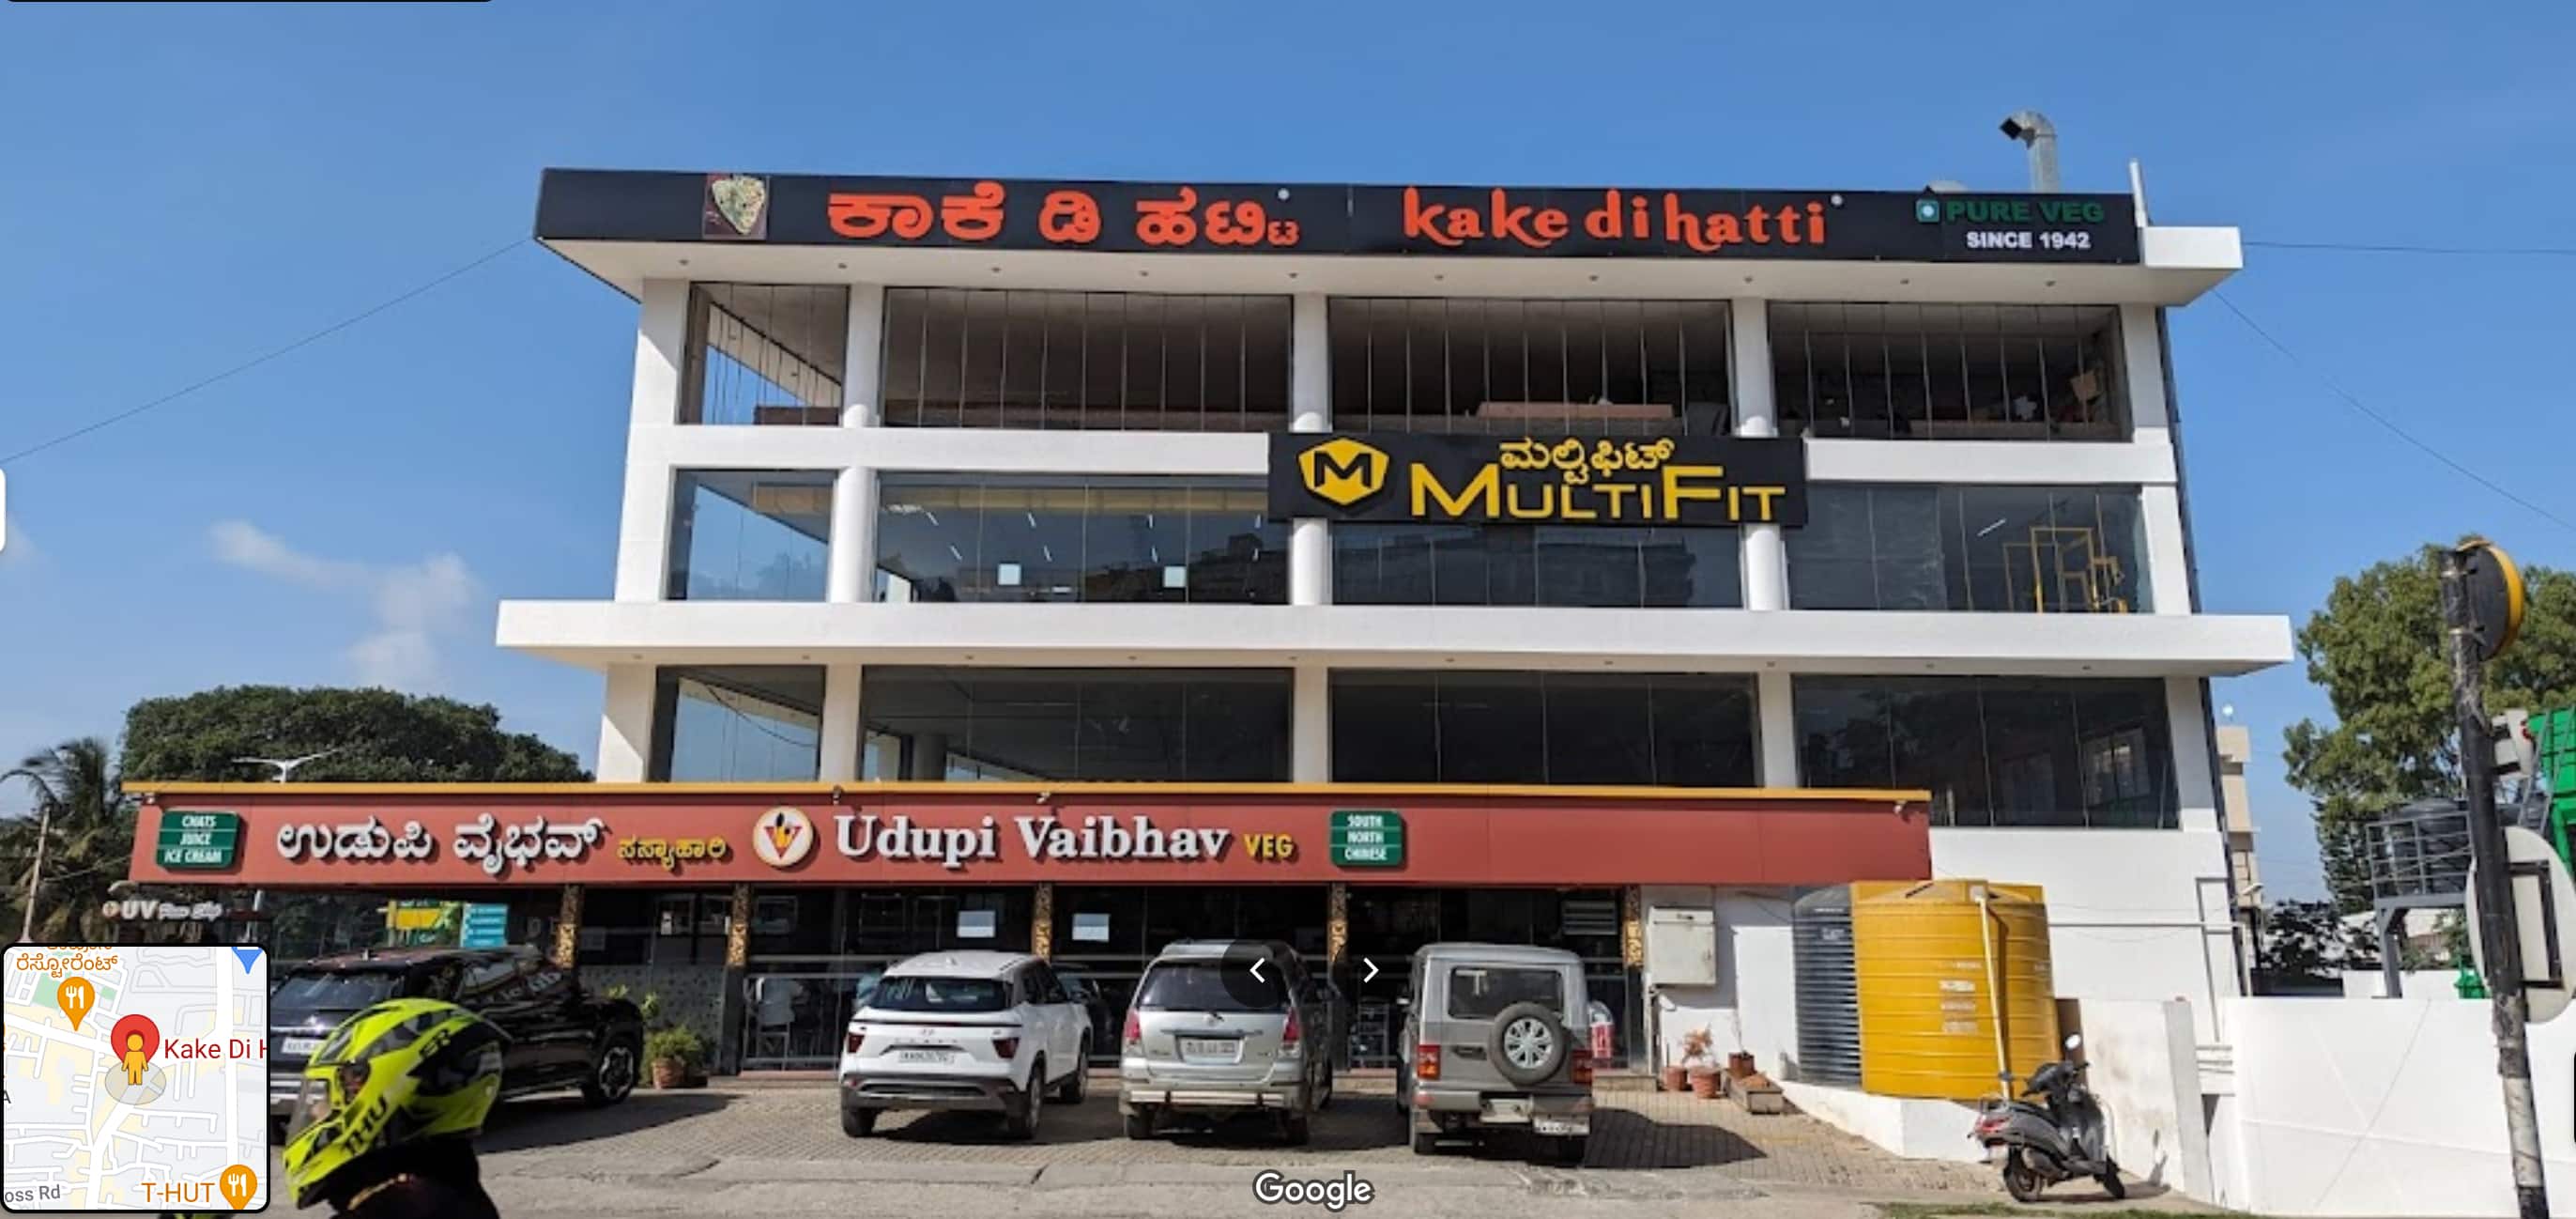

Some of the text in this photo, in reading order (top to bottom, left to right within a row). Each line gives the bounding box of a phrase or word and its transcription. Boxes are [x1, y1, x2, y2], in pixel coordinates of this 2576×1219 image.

[827, 181, 1005, 239] ಕಾಕೆ
[1038, 189, 1101, 244] ಡಿ
[1403, 187, 1825, 252] kake di hatti
[1945, 201, 2106, 224] PURE VEG
[1966, 231, 2092, 251] SINCE 1942
[1499, 437, 1675, 485] ಮಲ್ಟಿಫಿಟ್
[181, 814, 217, 827] CHATS
[1347, 813, 1384, 827] SOUTH
[180, 832, 212, 845] JUICE
[277, 812, 605, 874] ಉಡುಪಿ ವೈಭವ್
[835, 815, 1231, 866] Udupi Vaibhav
[1244, 834, 1294, 858] VEG
[1347, 830, 1385, 843] NORTH
[163, 848, 222, 863] ICE CREAM
[617, 835, 727, 870] ಸಸ್ಯಾಹಾರಿ
[1344, 846, 1388, 860] CHINESE
[121, 900, 159, 919] UV
